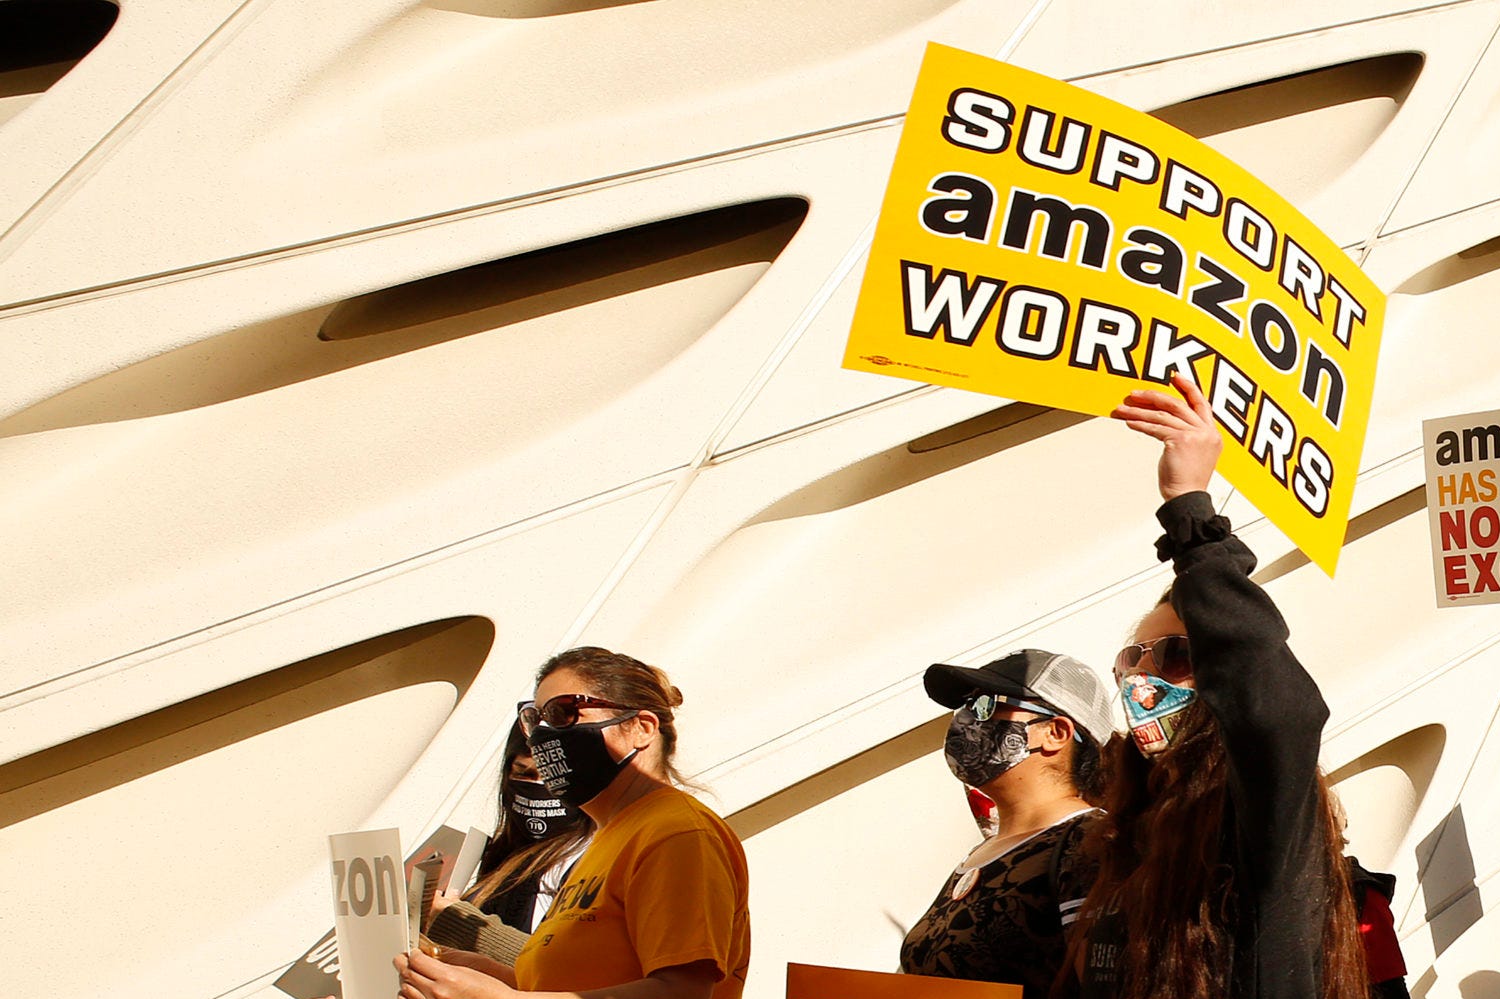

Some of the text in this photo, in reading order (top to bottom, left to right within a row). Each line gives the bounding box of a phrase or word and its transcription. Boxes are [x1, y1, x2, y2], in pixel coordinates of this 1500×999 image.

[941, 86, 1367, 351] SUPPORT
[921, 173, 1346, 430] amazon
[900, 259, 1334, 518] WORKERS
[1437, 469, 1498, 507] HAS
[1440, 505, 1500, 551] NO
[543, 739, 561, 751] HERO
[529, 799, 561, 808] WORKERS
[532, 809, 546, 817] THIS
[546, 808, 567, 817] MASK
